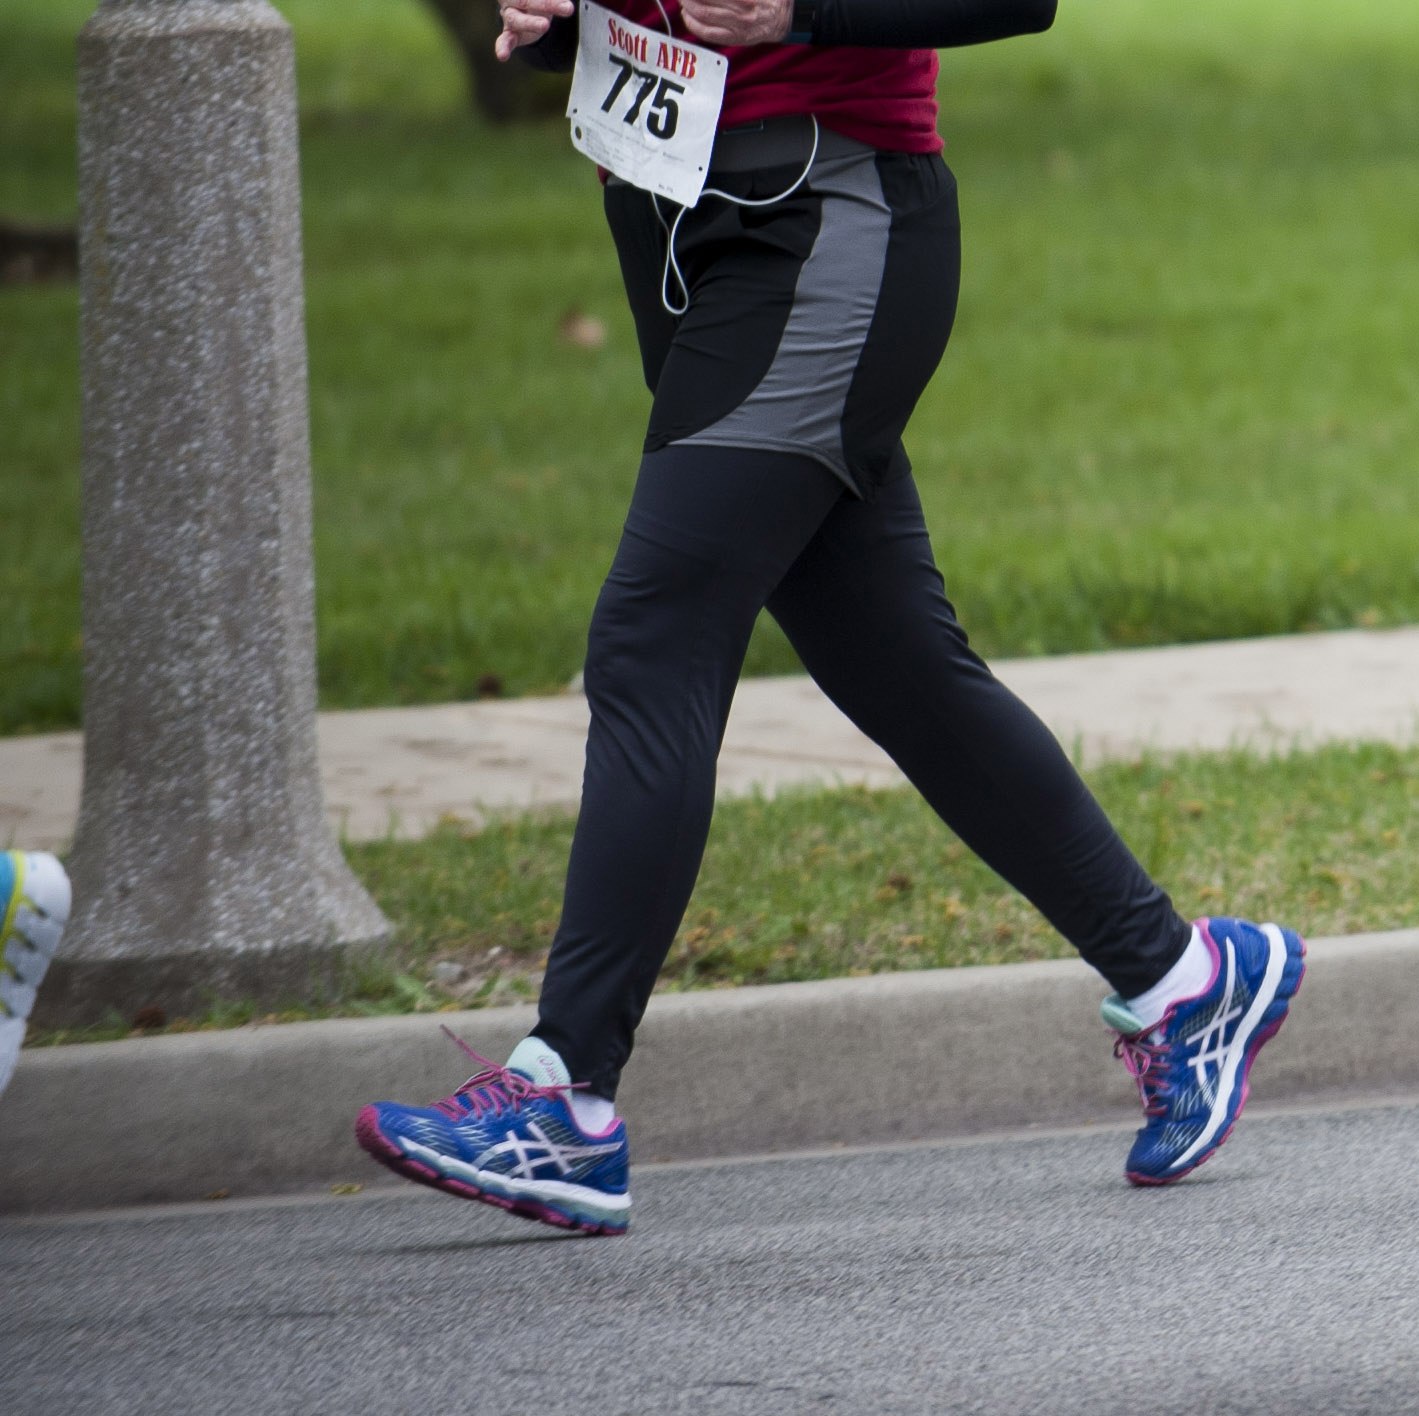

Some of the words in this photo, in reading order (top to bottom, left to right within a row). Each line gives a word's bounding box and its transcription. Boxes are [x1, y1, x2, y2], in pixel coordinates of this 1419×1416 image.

[608, 17, 649, 63] Scott
[656, 41, 697, 80] AFB
[601, 52, 686, 140] 775
